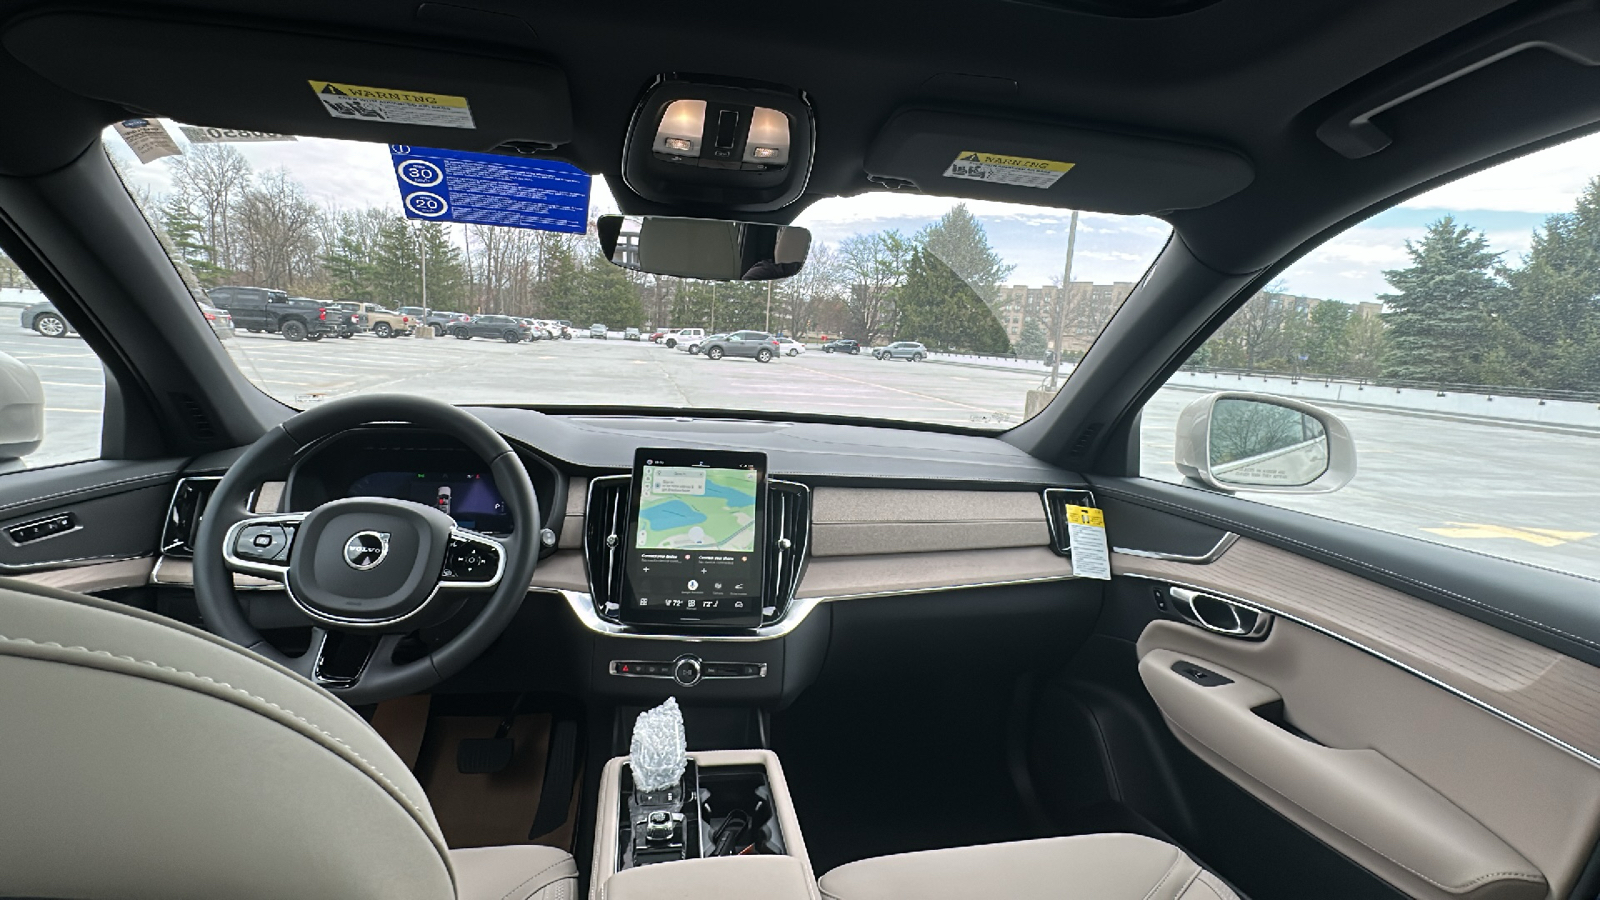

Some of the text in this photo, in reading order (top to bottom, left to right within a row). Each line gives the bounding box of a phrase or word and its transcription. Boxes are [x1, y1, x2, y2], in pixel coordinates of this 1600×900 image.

[348, 87, 438, 104] WARNING
[984, 156, 1049, 169] WARNING
[408, 167, 433, 179] 30
[415, 199, 438, 209] 20
[349, 545, 381, 553] VOLVO
